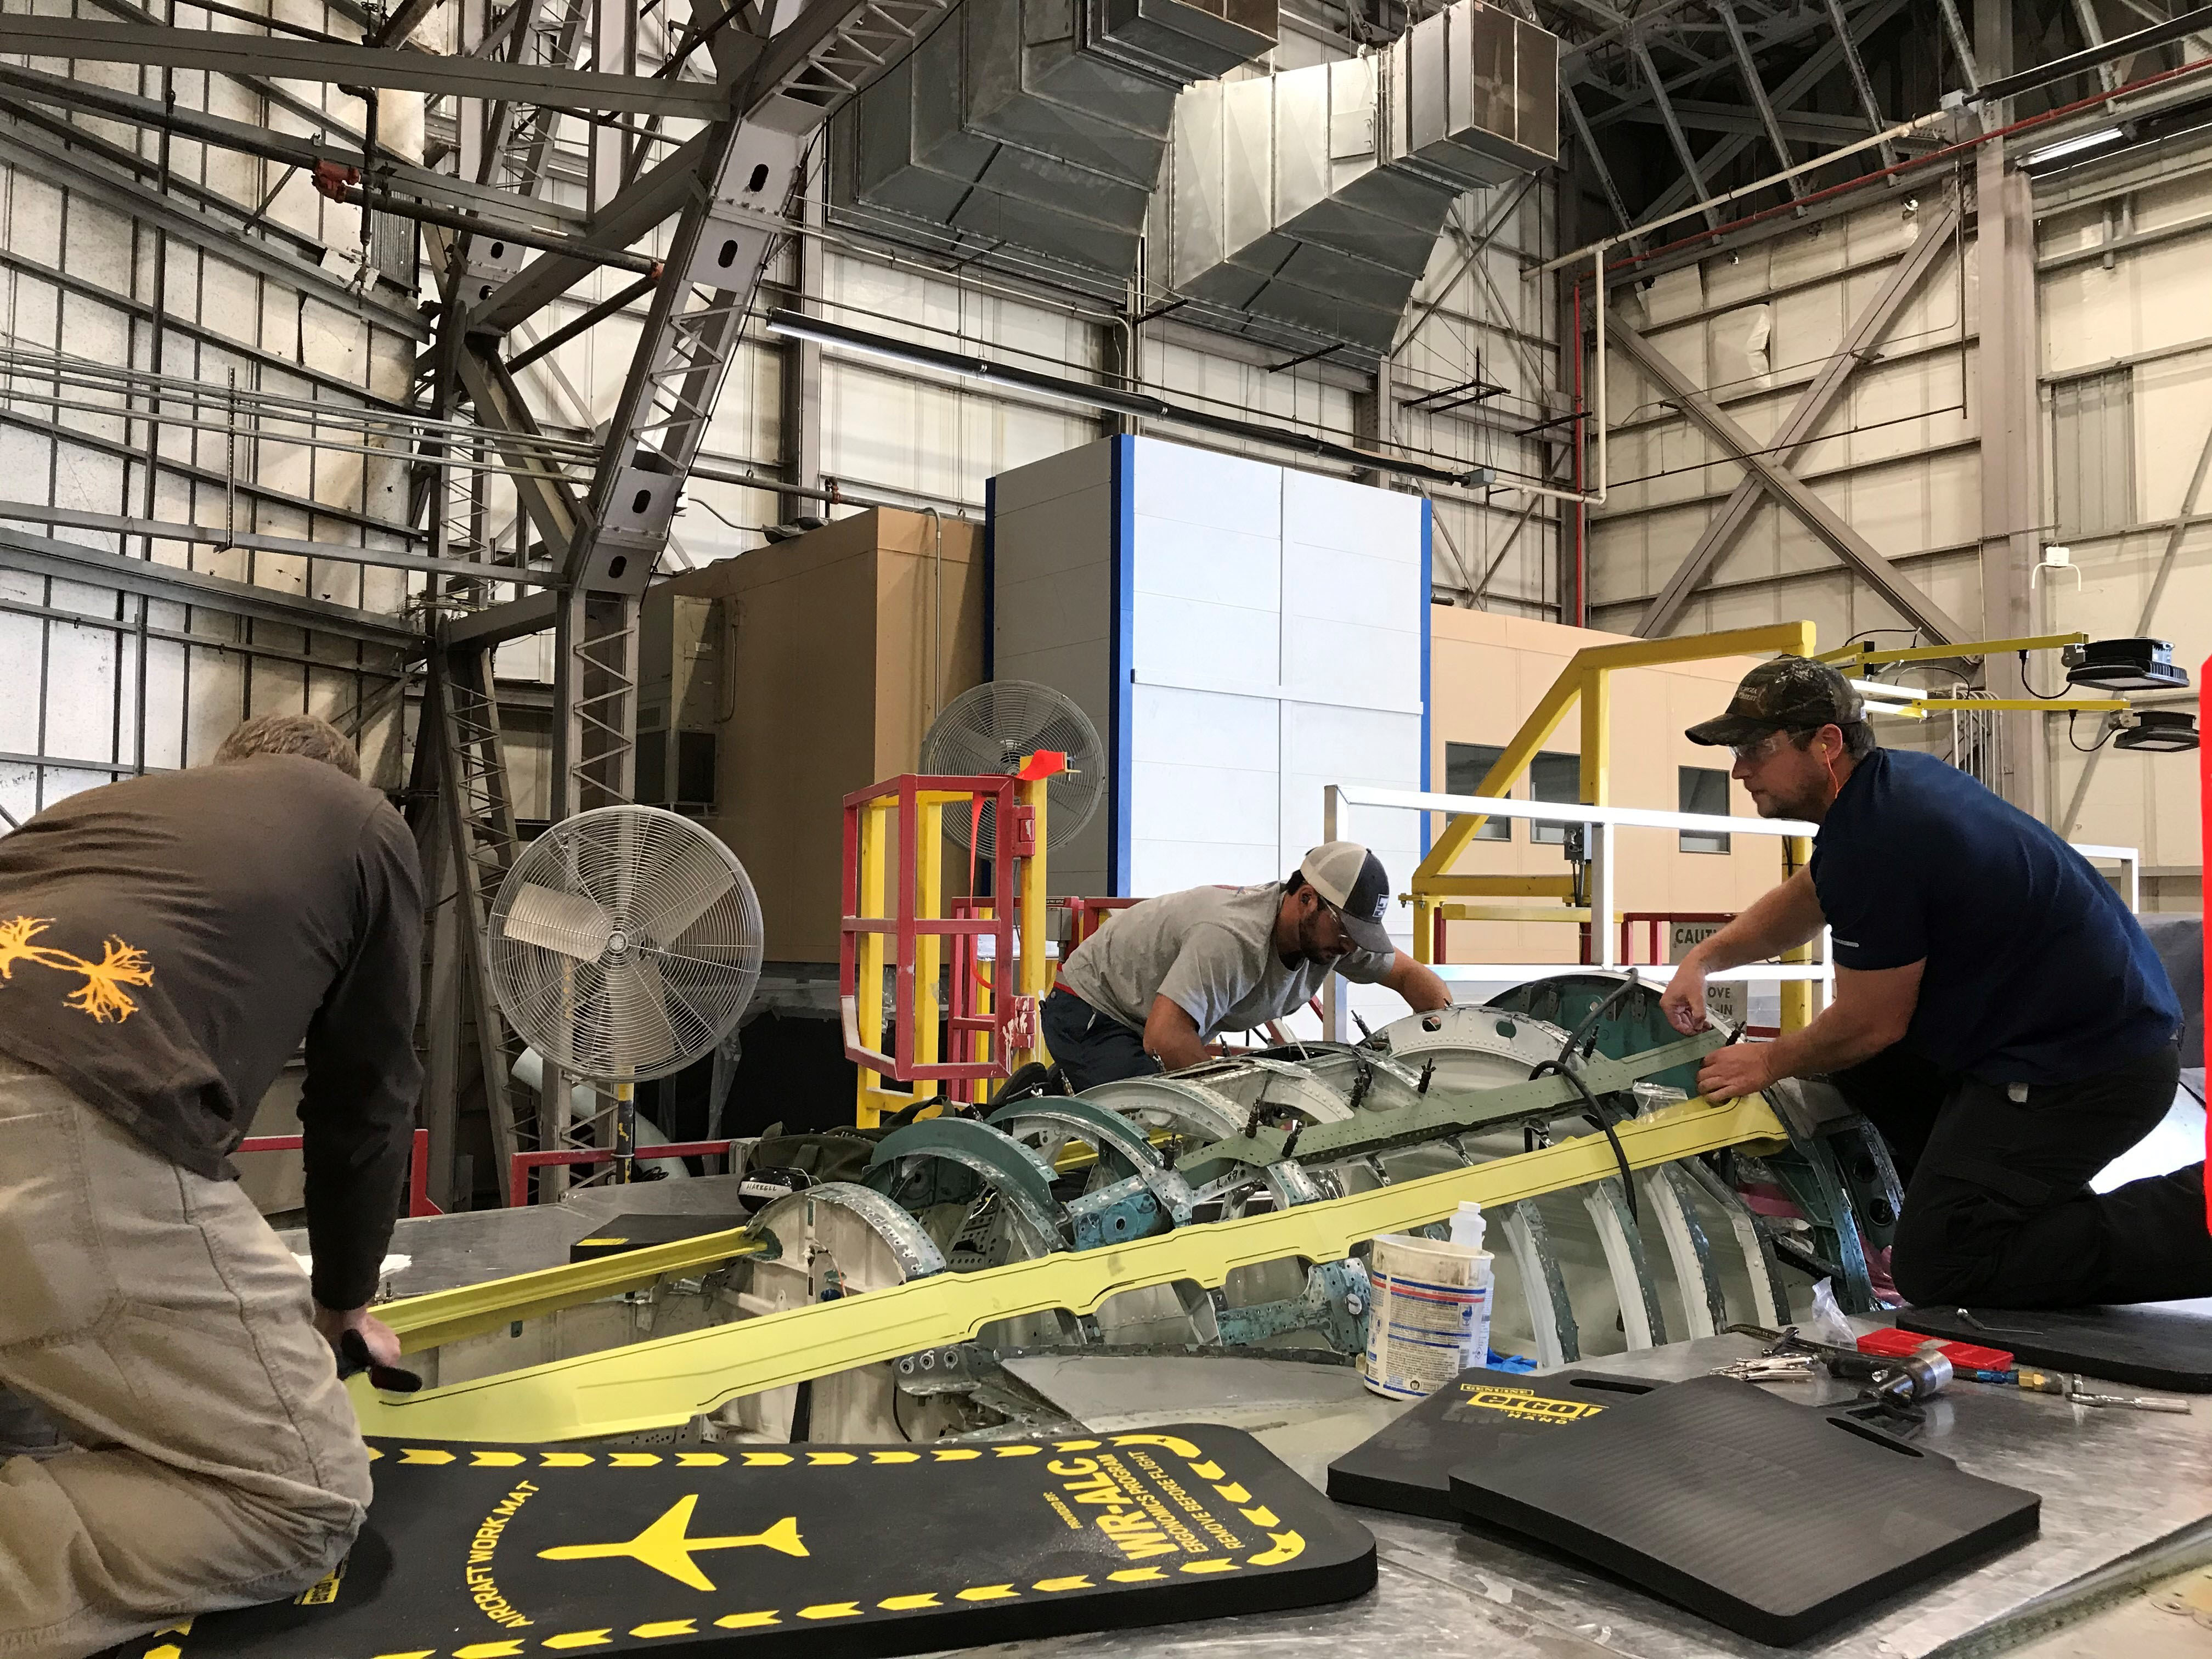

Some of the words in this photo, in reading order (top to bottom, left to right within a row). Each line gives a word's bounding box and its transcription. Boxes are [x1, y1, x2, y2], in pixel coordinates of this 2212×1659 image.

[1675, 928, 1717, 944] CAUT
[1707, 986, 1730, 998] OVE
[1096, 1453, 1149, 1495] PROGRAM
[1127, 1451, 1169, 1480] FLIGHT
[492, 1480, 540, 1516] MAT
[1047, 1457, 1180, 1561] WR-ALC
[1156, 1478, 1204, 1512] BEFORE
[467, 1516, 510, 1564] WORK
[1135, 1494, 1210, 1553] ERGONOMICS
[1191, 1511, 1246, 1550] REMOVE
[466, 1566, 535, 1629] AIRCRAFT
